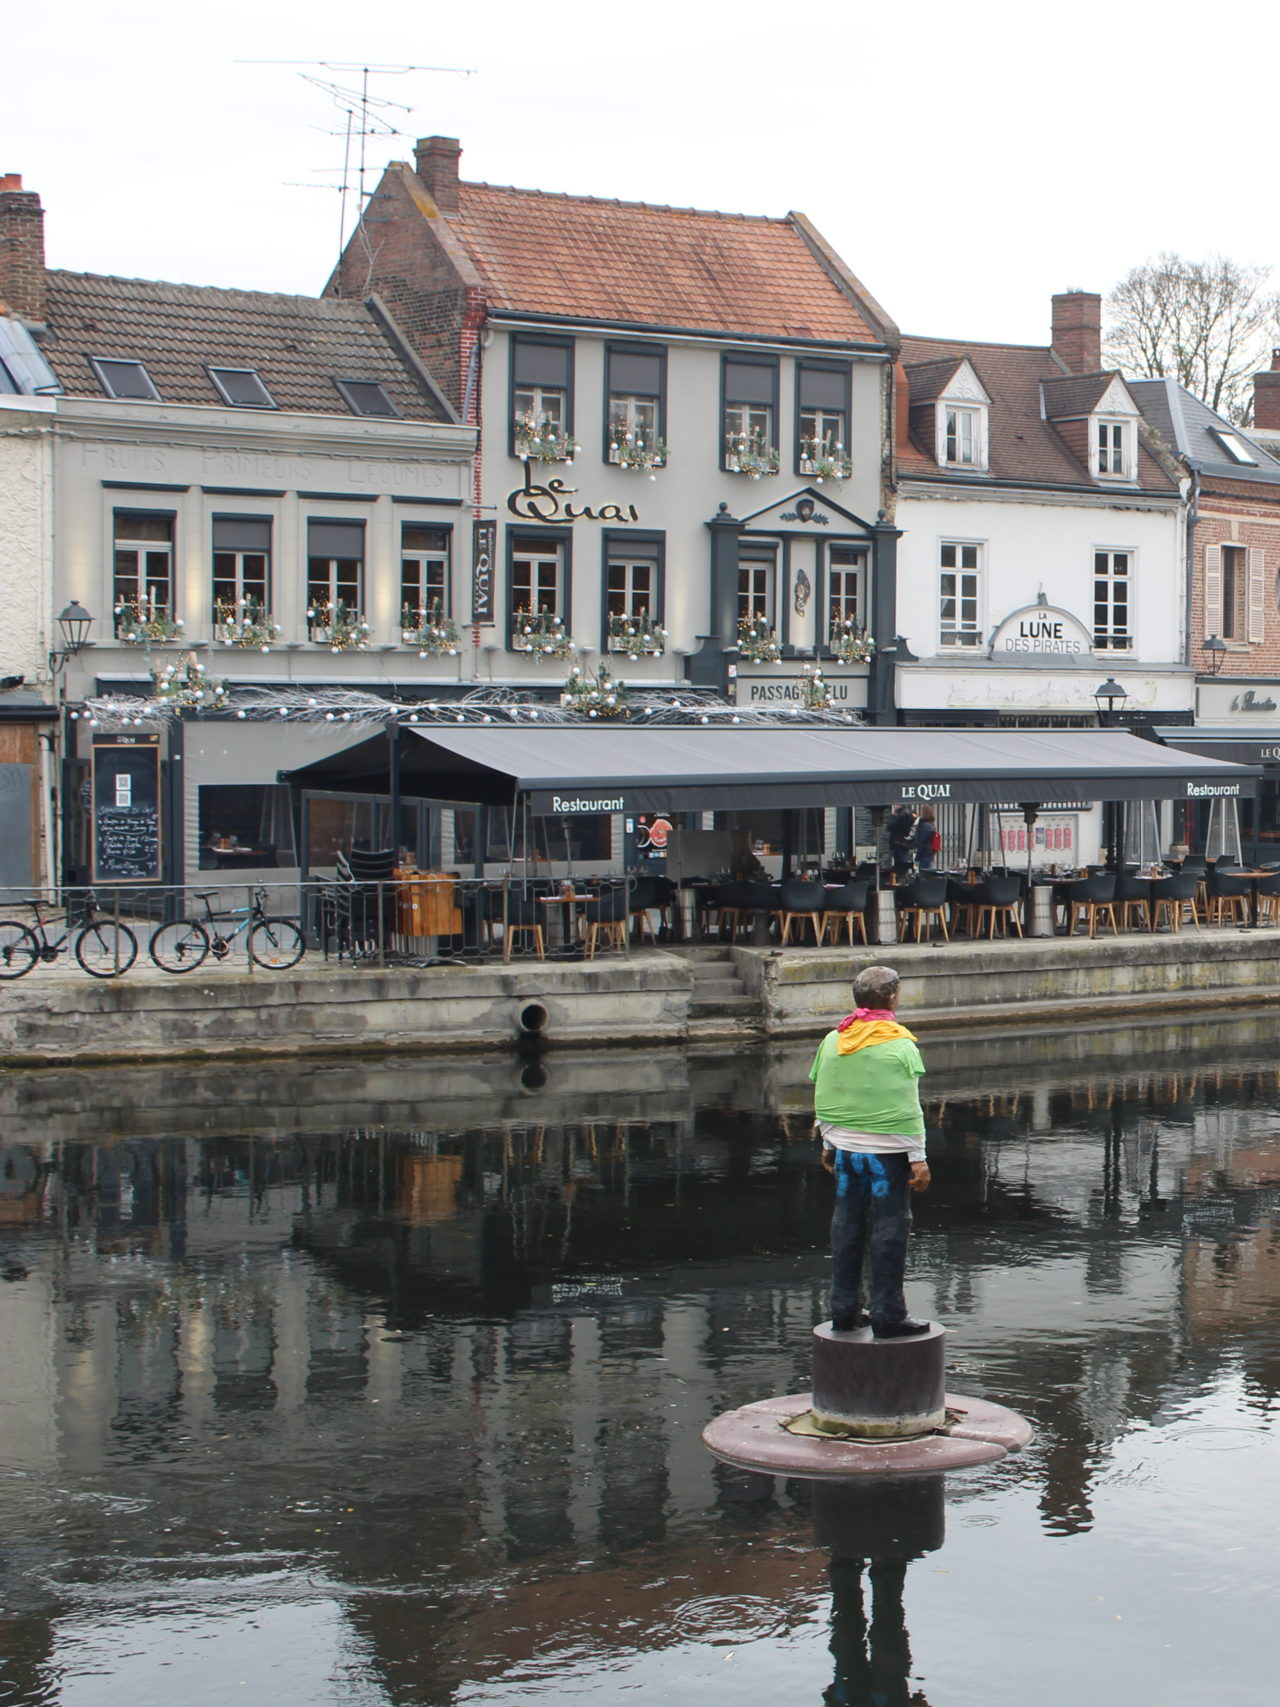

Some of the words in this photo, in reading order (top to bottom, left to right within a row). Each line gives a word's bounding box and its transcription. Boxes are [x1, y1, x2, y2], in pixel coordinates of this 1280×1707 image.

[523, 459, 579, 496] Le
[507, 485, 638, 524] Quai
[479, 528, 487, 549] LE
[476, 553, 489, 614] QUAI
[1038, 612, 1047, 620] LA
[1020, 621, 1063, 639] LUNE
[1005, 638, 1029, 652] DES
[1033, 640, 1080, 654] PIRATES
[751, 685, 804, 700] PASSAG
[816, 683, 848, 700] ELU
[1260, 748, 1271, 758] LE
[901, 787, 915, 798] LE
[917, 784, 951, 800] QUAI
[1187, 782, 1240, 796] Restaurant
[552, 796, 624, 812] Restaurant
